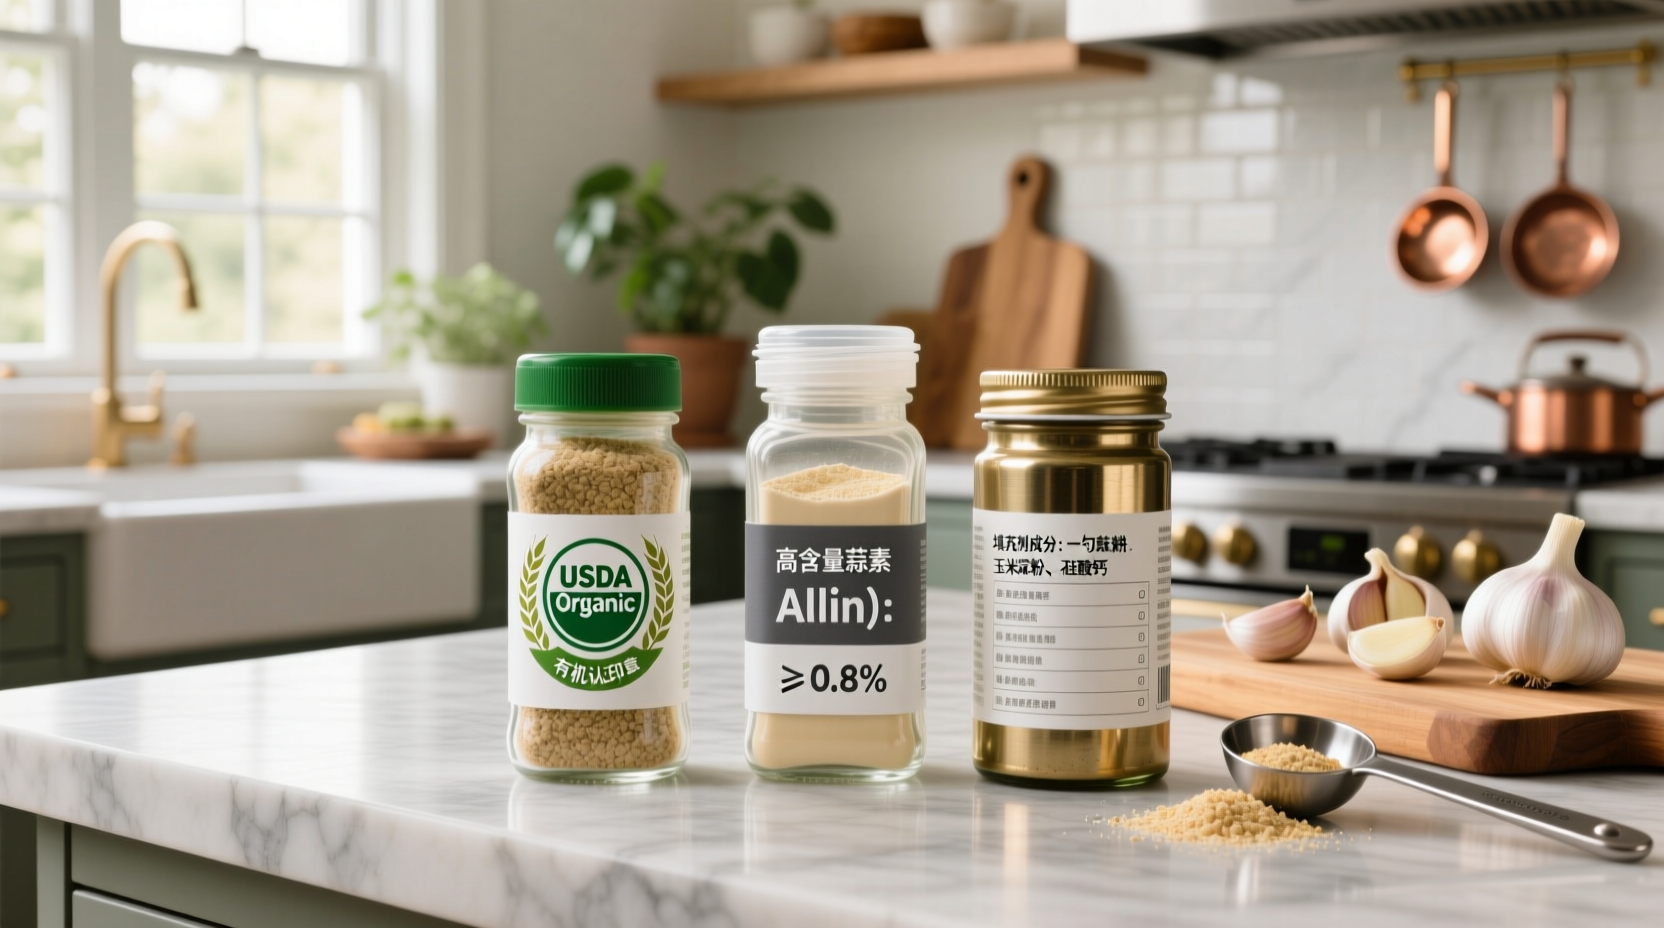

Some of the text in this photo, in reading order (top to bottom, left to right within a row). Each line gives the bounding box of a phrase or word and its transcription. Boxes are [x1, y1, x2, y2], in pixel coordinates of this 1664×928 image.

[776, 547, 891, 573] 高含量蒜素
[560, 565, 632, 588] USDA
[555, 592, 636, 618] Organic
[776, 586, 893, 631] Allin):
